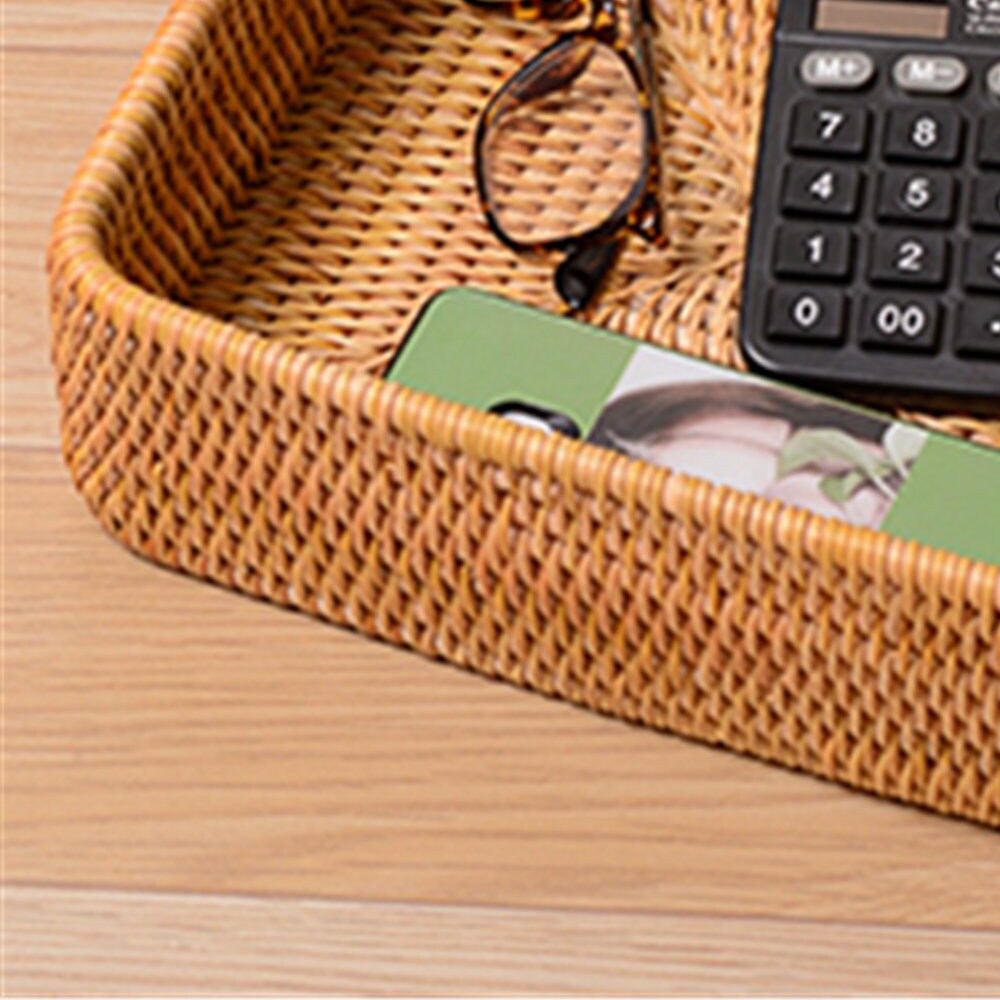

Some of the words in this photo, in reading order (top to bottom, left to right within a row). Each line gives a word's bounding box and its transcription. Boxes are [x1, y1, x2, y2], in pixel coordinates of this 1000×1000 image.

[819, 110, 843, 140] 7
[912, 118, 937, 148] 8
[810, 171, 834, 199] 4
[905, 178, 931, 208] 5
[807, 235, 824, 263] 1
[898, 241, 924, 271] 2
[794, 297, 820, 327] 0
[877, 303, 925, 336] 00
